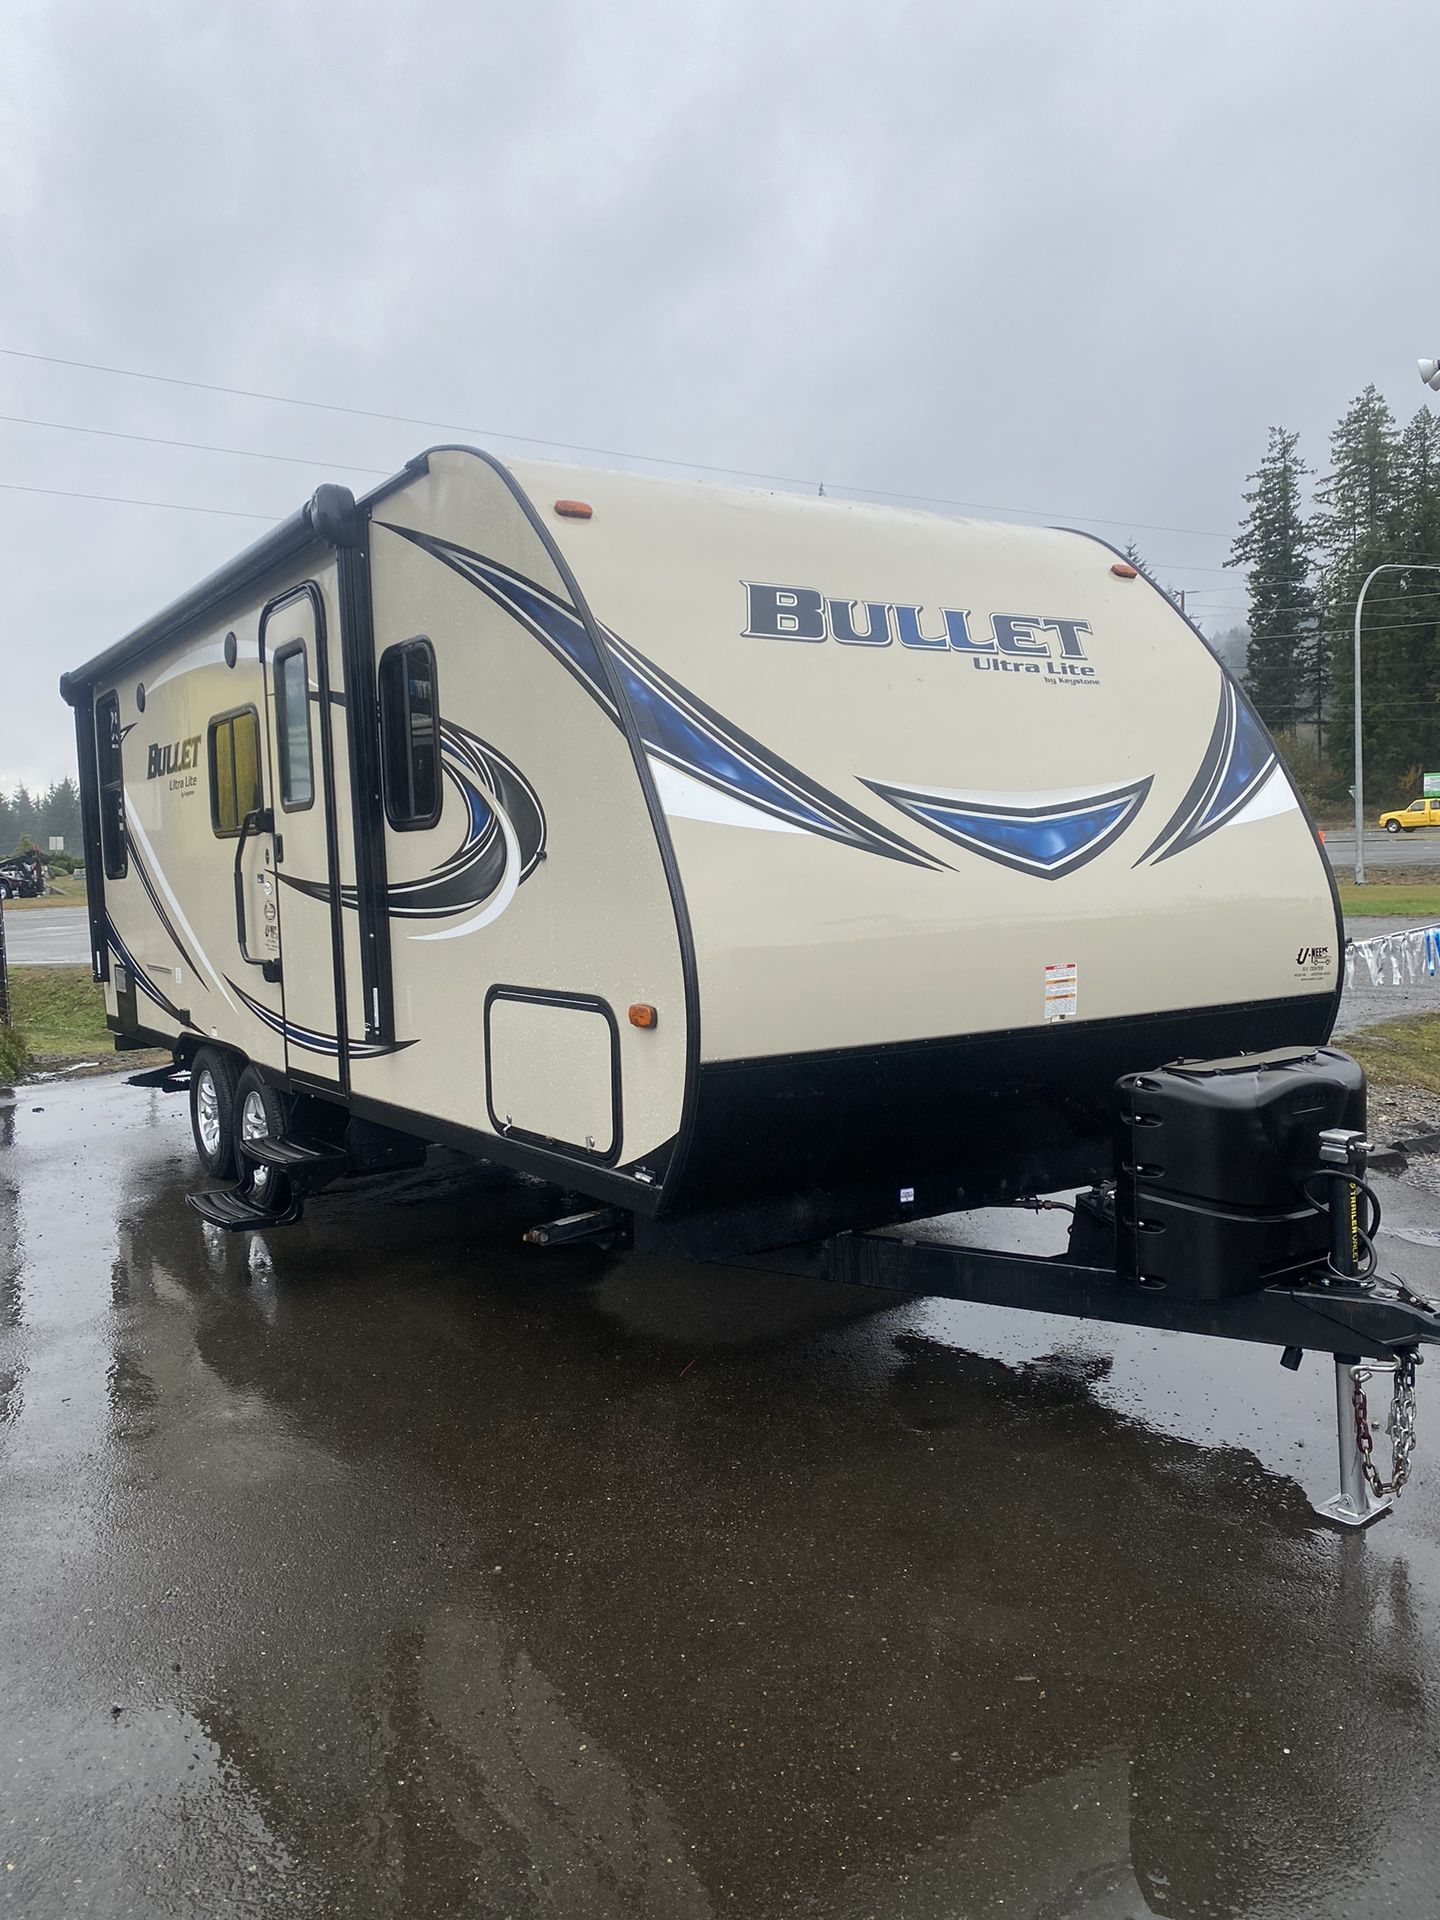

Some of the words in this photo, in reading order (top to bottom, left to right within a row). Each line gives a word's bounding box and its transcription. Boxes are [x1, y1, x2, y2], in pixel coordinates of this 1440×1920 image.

[739, 580, 1093, 660] BULLET
[973, 657, 1040, 673] Ultra
[1046, 662, 1095, 677] Lite
[1044, 676, 1057, 685] by
[1059, 677, 1100, 686] Keystone
[147, 734, 202, 780] BULLET
[1350, 1190, 1358, 1234] TRAILER
